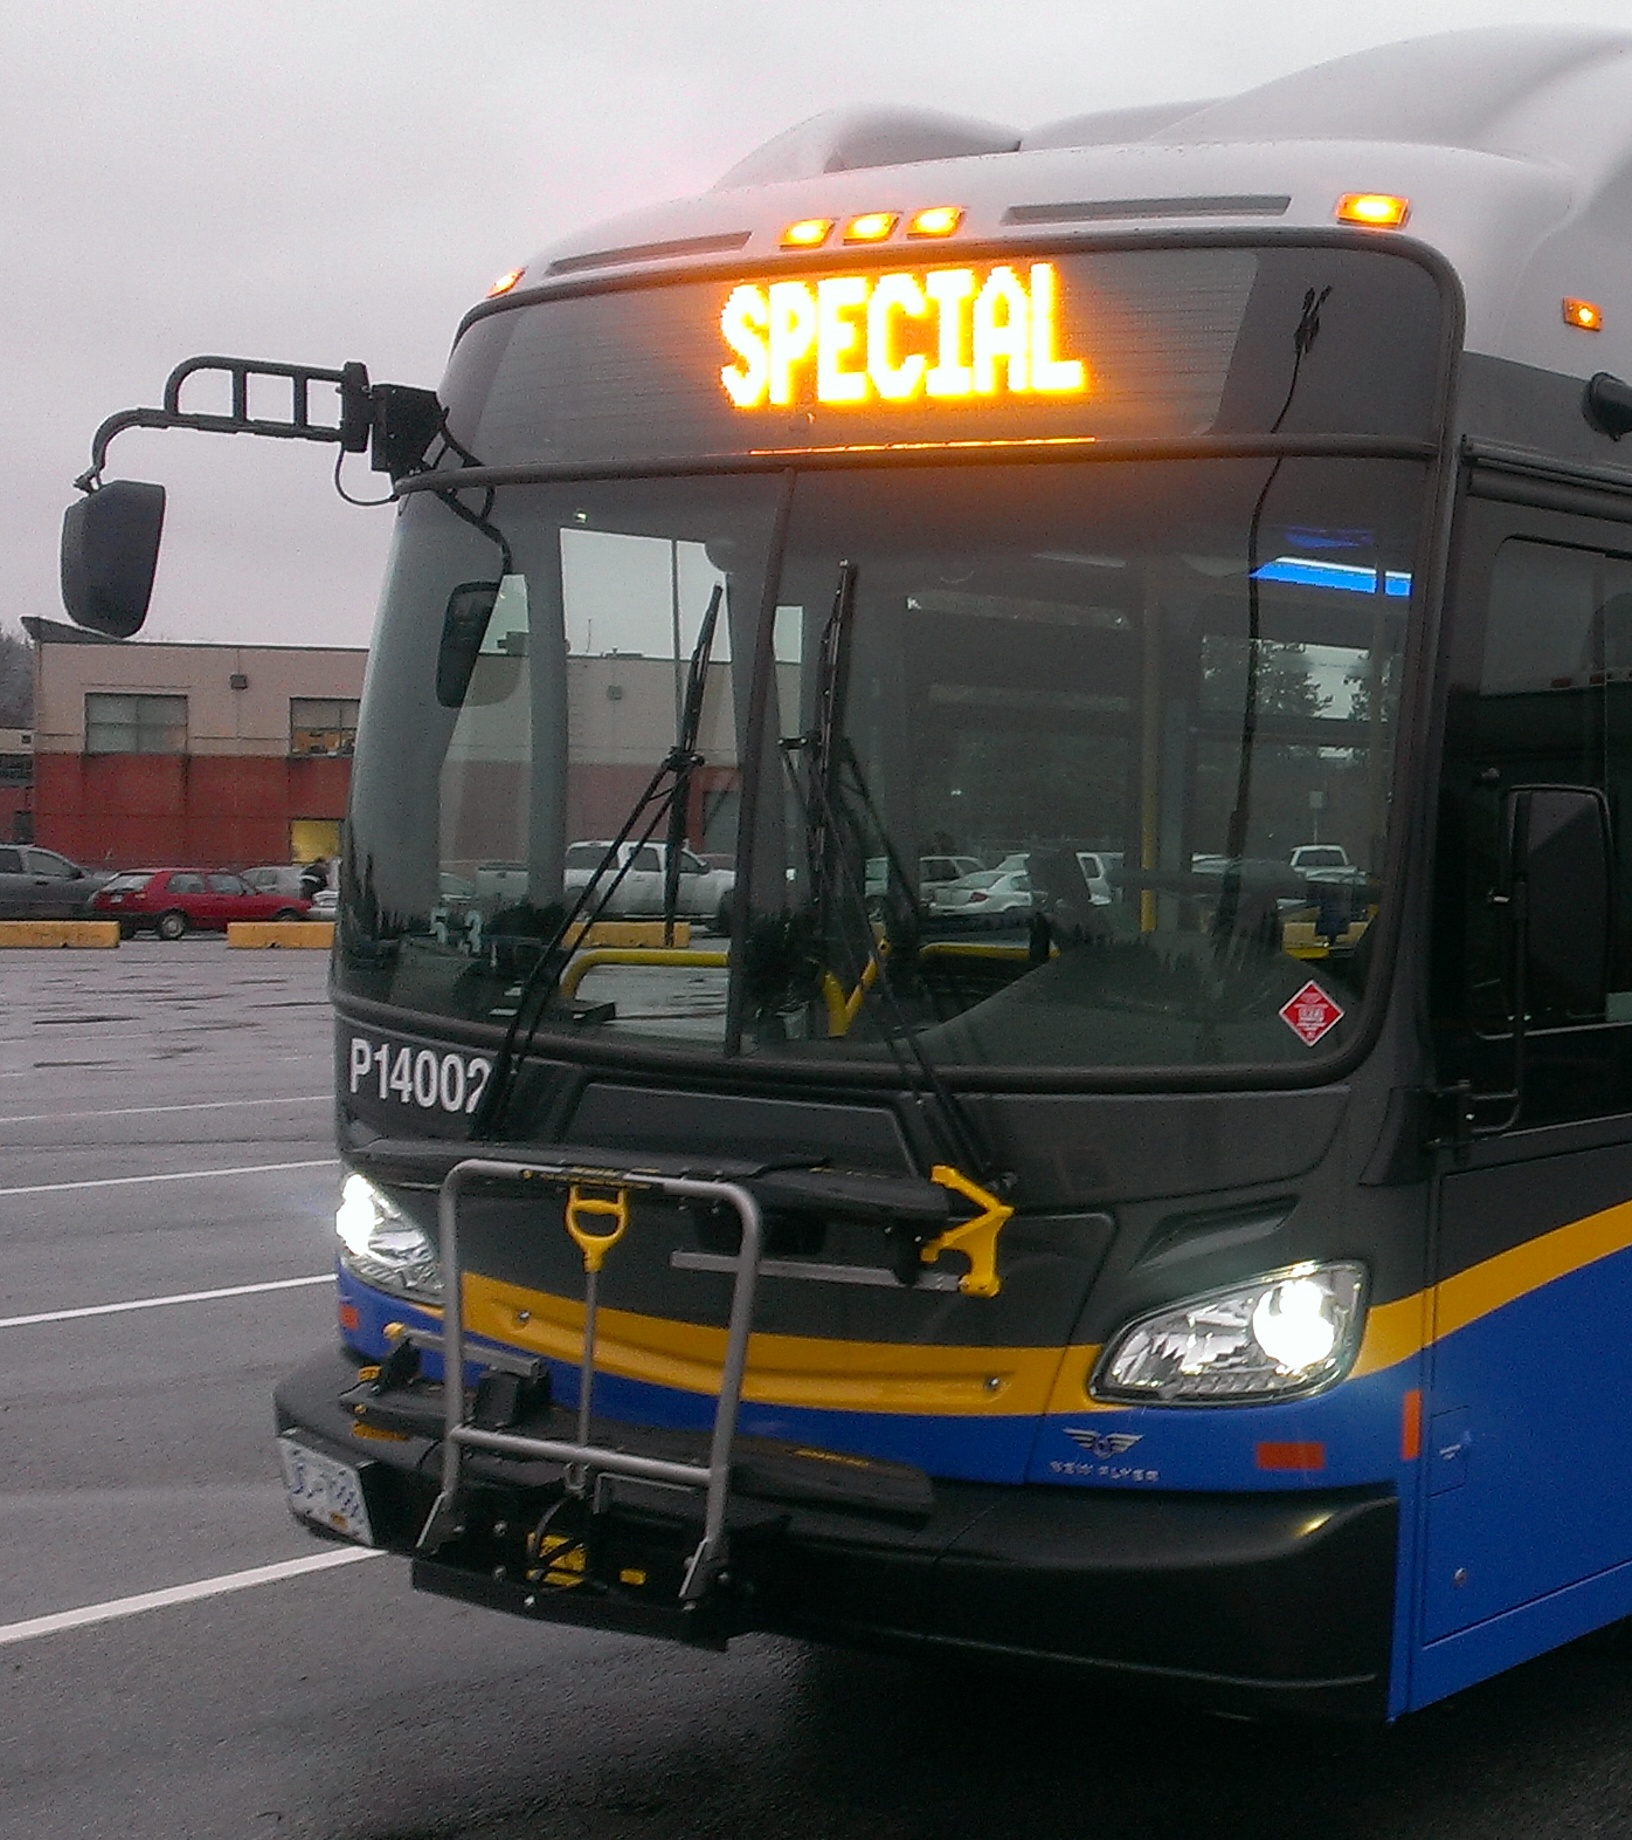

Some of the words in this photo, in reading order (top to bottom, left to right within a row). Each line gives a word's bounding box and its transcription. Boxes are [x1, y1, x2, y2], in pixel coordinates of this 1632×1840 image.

[719, 262, 1086, 408] SPECIAL
[351, 1037, 491, 1114] P14002
[1050, 1460, 1094, 1476] NEW
